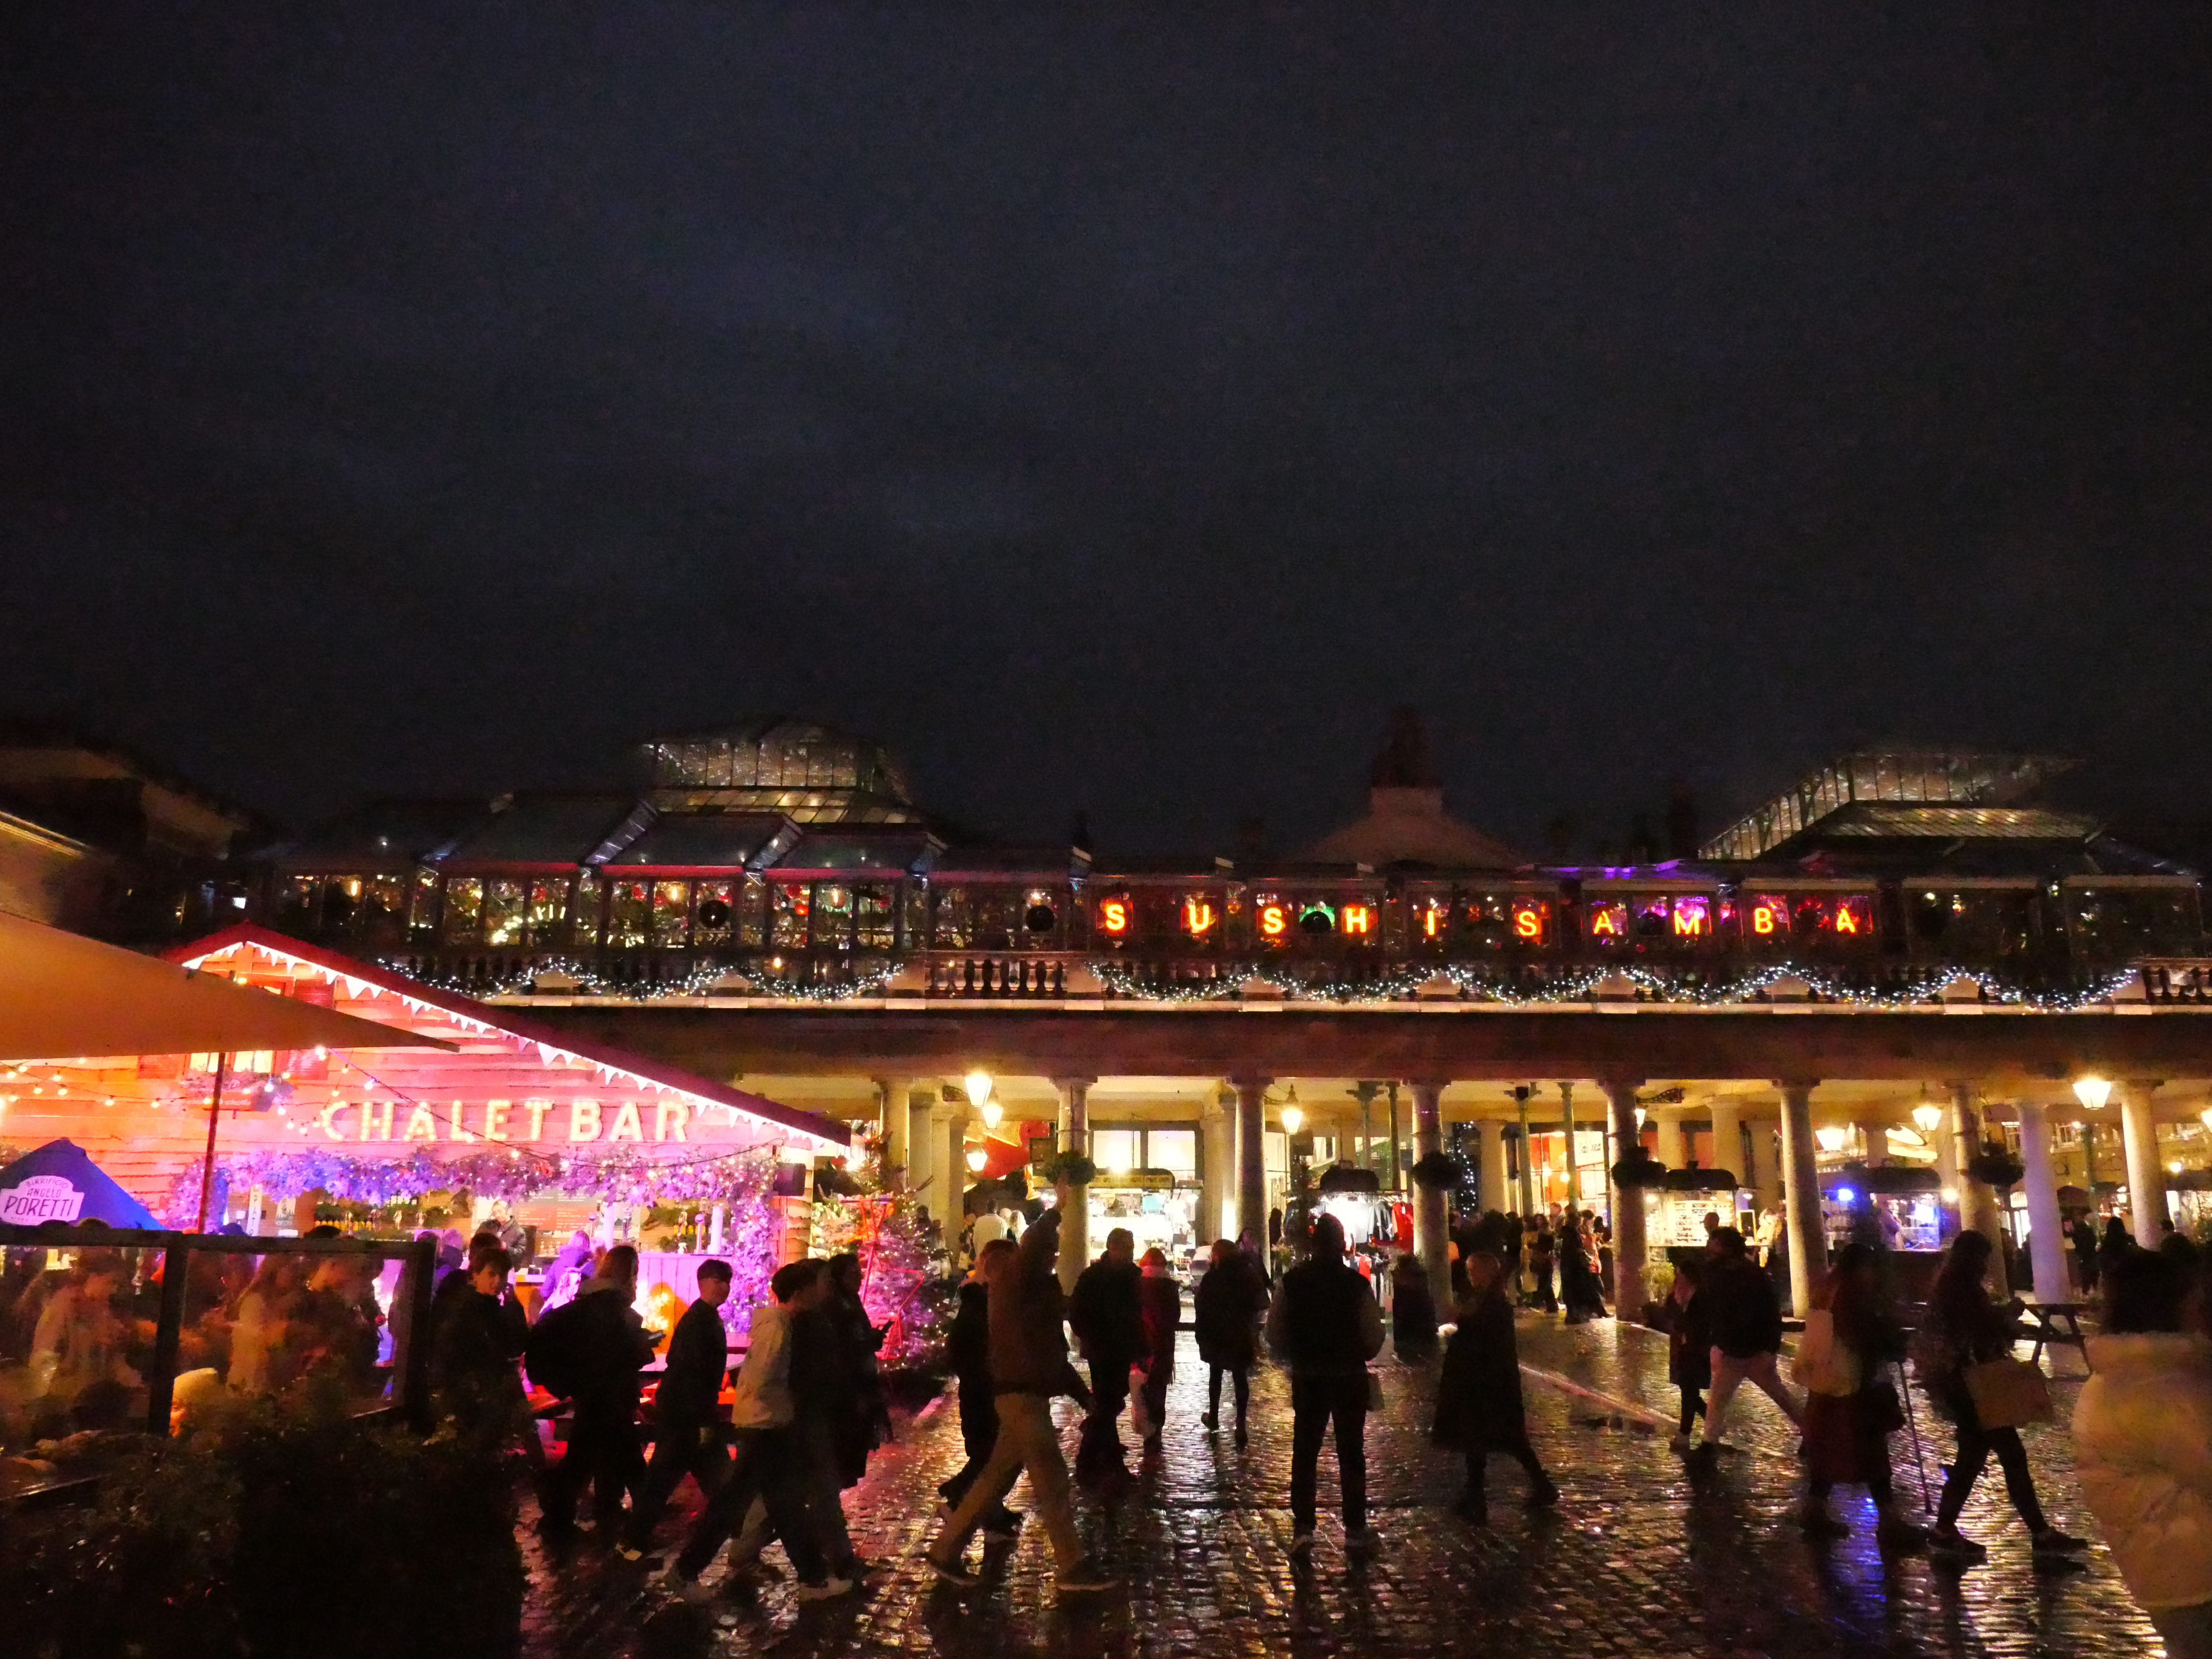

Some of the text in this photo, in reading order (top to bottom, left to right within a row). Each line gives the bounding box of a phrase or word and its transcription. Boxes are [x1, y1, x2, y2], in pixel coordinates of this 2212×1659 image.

[321, 1099, 689, 1143] CHALET BAR
[26, 1178, 69, 1189] BIRRIFICIO
[27, 1187, 61, 1198] ANGELO
[4, 1195, 74, 1217] PORETTI
